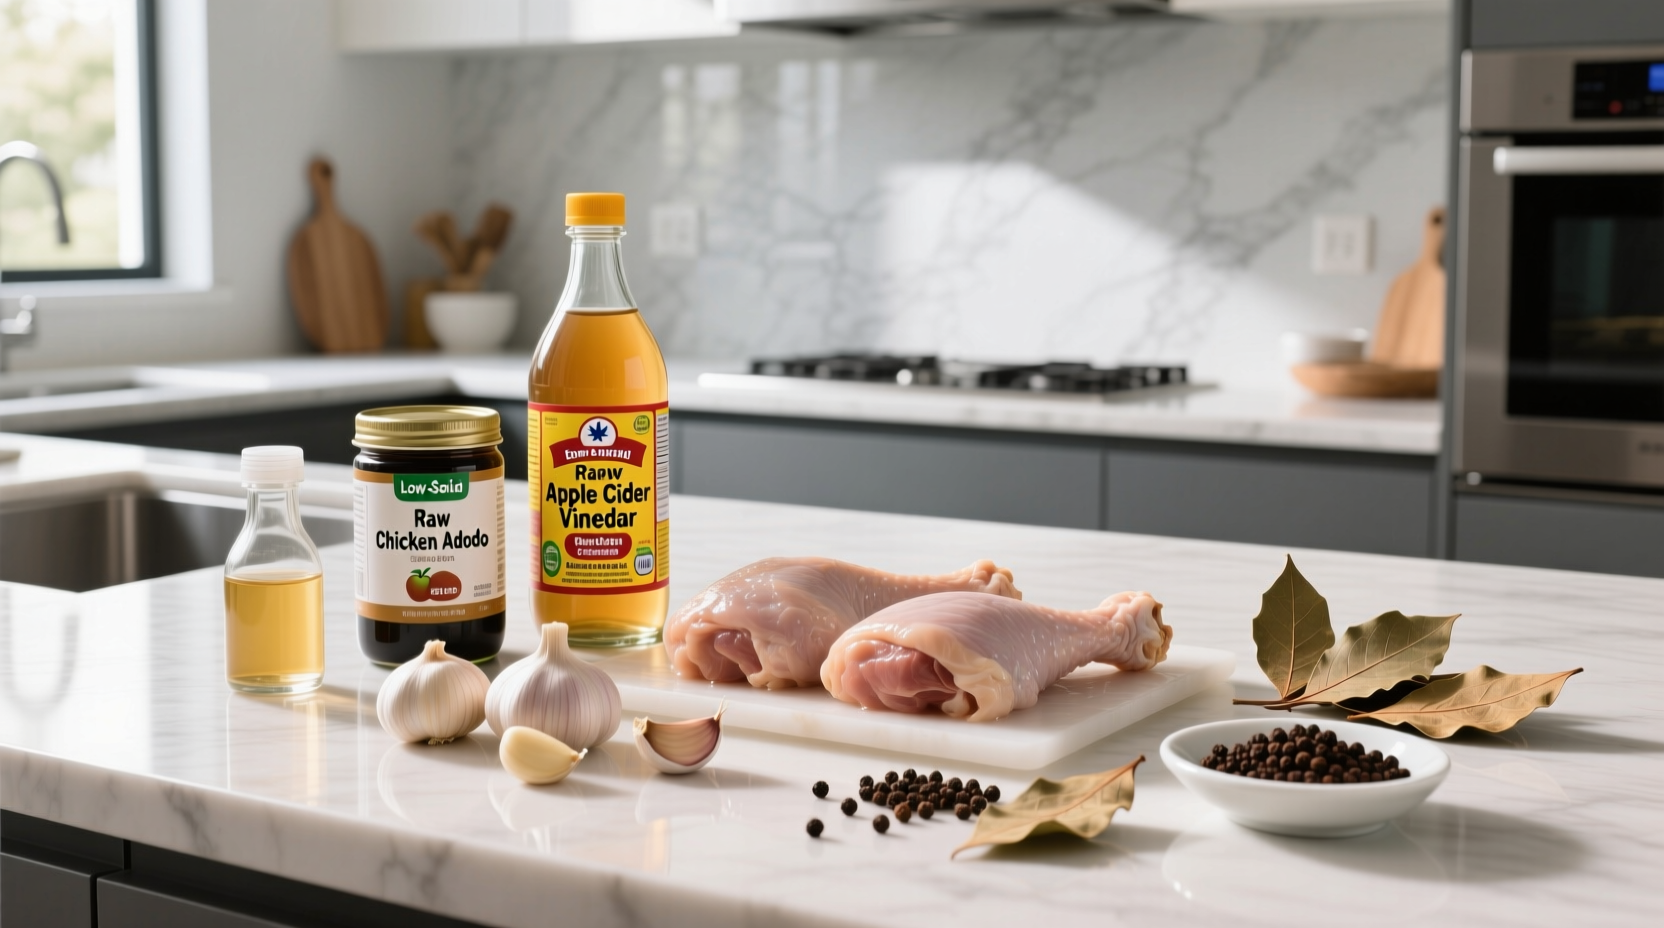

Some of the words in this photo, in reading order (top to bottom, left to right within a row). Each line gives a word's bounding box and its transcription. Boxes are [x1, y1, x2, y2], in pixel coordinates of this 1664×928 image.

[545, 482, 598, 508] Apple
[602, 481, 651, 504] Cider
[414, 508, 451, 528] Raw
[558, 507, 638, 529] Vinedar
[376, 529, 438, 551] Chicken
[442, 527, 489, 550] Adodo
